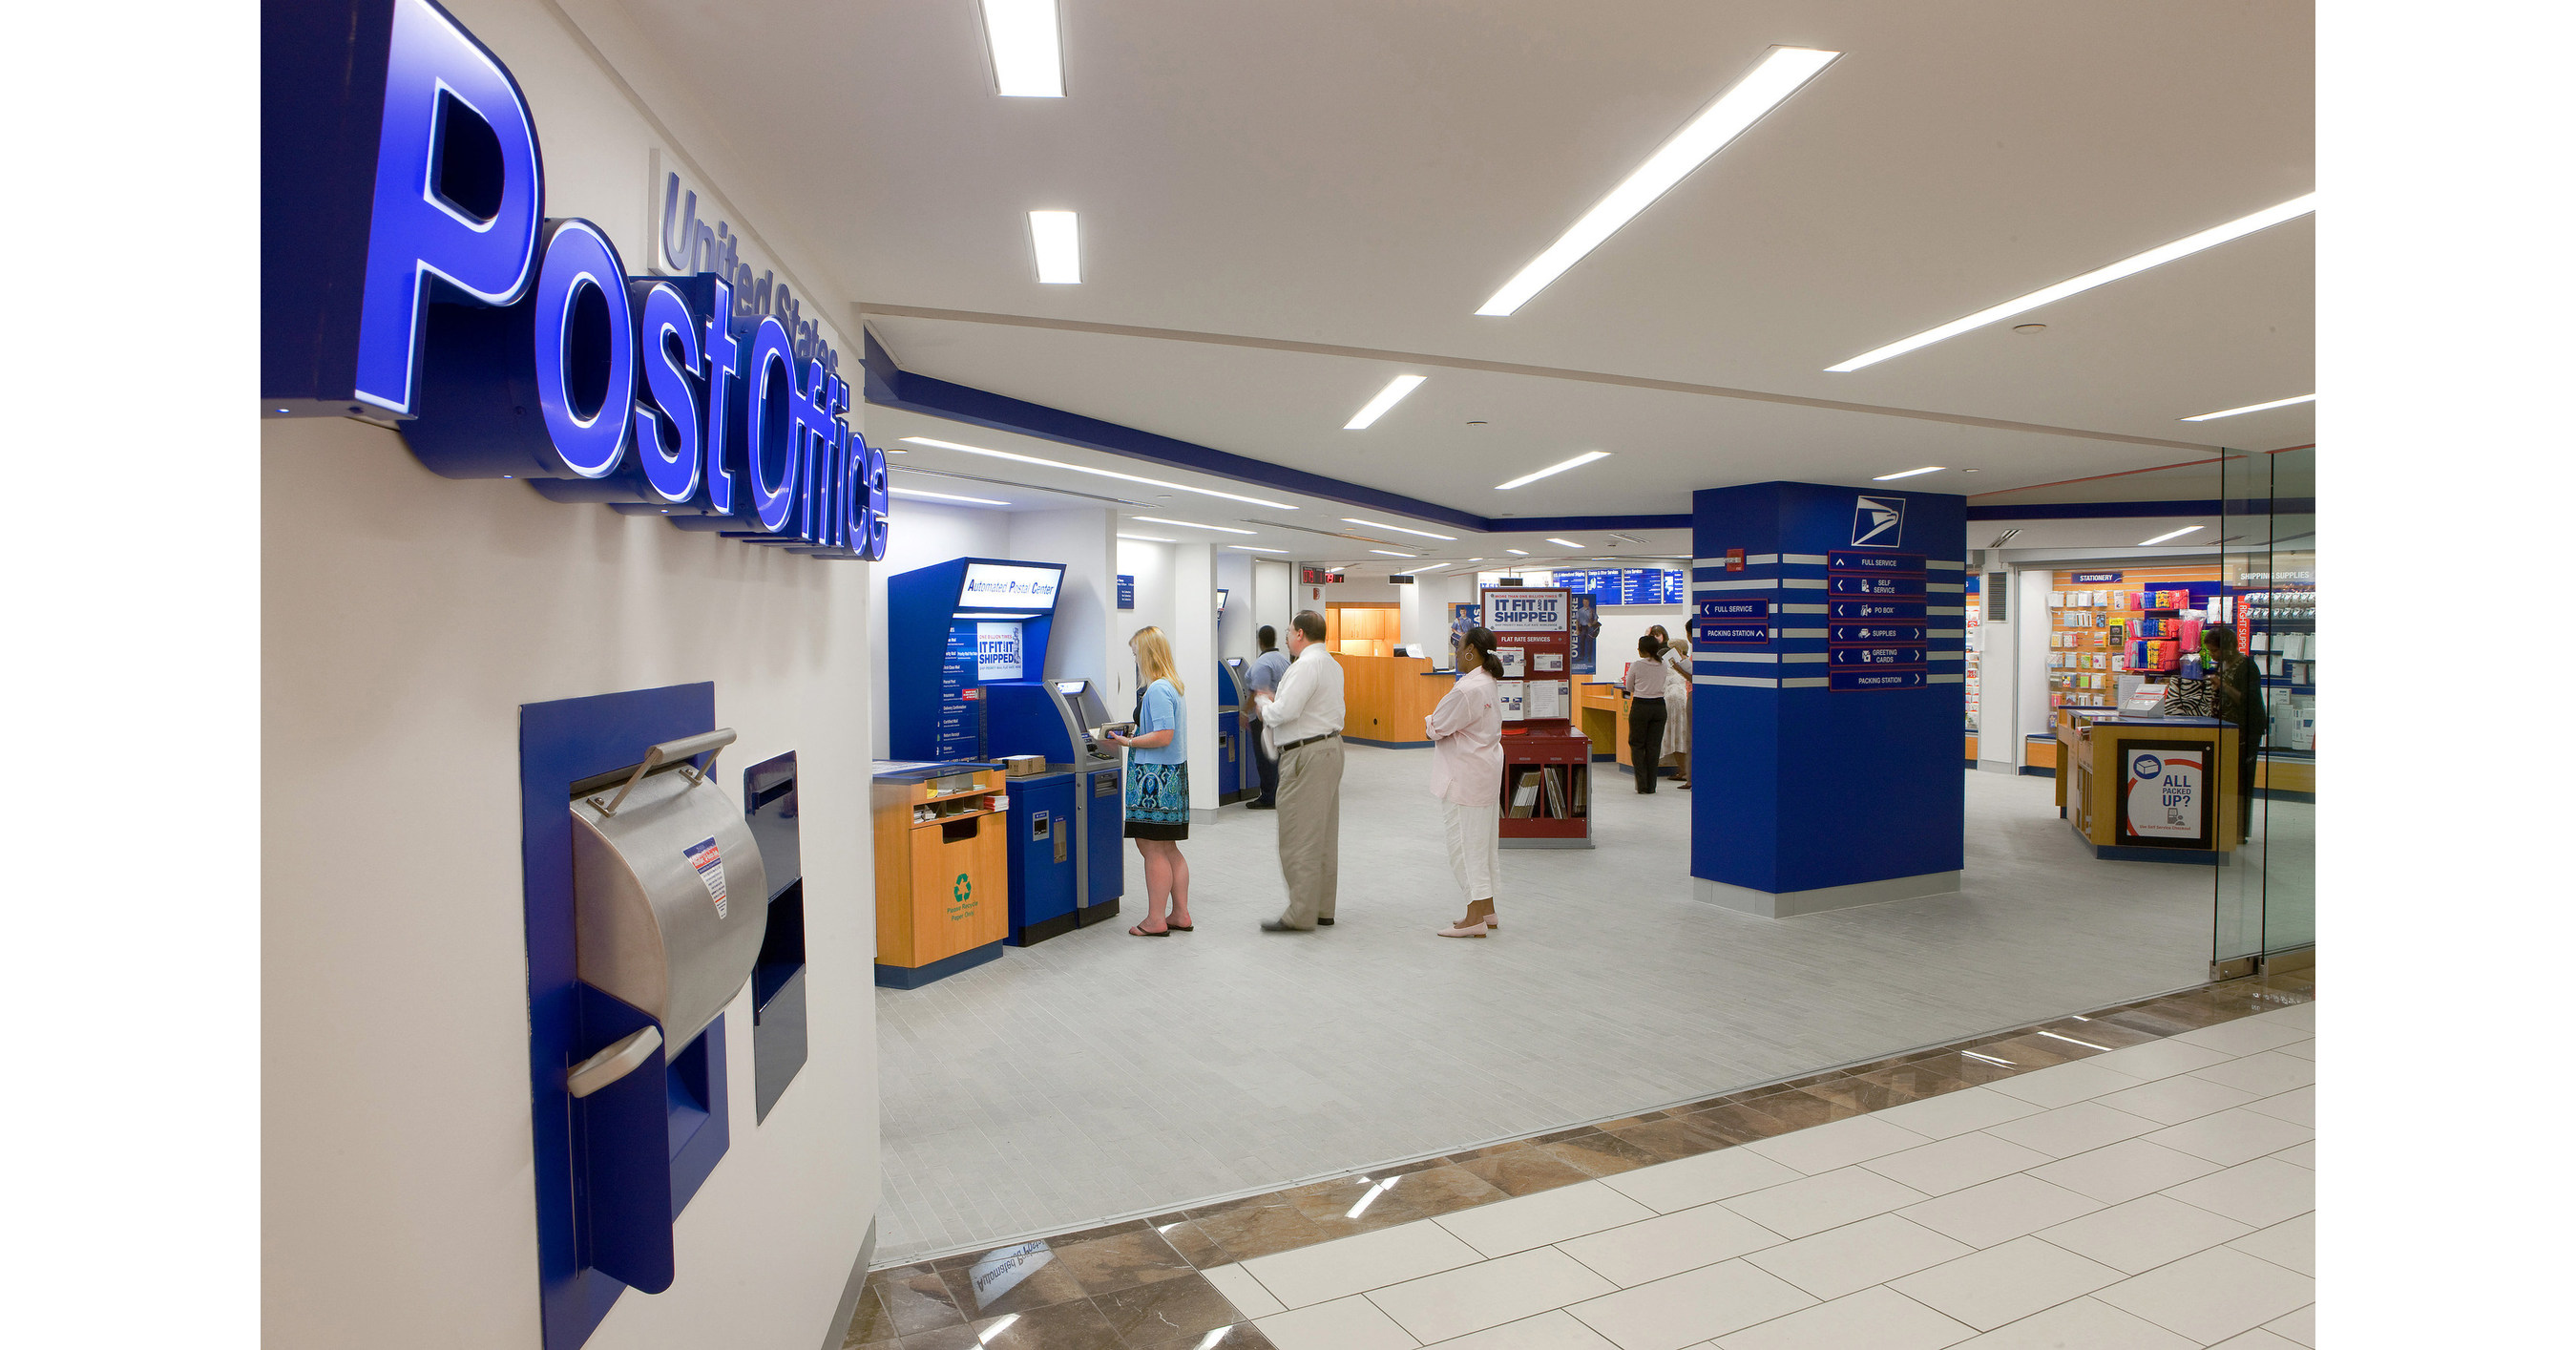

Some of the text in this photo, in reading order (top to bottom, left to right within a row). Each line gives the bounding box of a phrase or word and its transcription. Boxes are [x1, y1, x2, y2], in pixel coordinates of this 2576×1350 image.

[663, 171, 839, 375] United States
[354, 0, 889, 562] Post Office
[967, 579, 1055, 595] Automated Postal Center
[1495, 600, 1509, 611] IT
[1512, 600, 1536, 611] FIT
[1543, 600, 1558, 611] IT
[1494, 611, 1558, 622] SHIPPED
[979, 641, 988, 653] IT
[989, 641, 1003, 653] FIT
[1006, 641, 1014, 653] IT
[2238, 628, 2247, 656] SUPPLI
[979, 653, 1014, 664] SHIPPED
[2163, 774, 2191, 788] ALL
[2162, 794, 2191, 808] UP?
